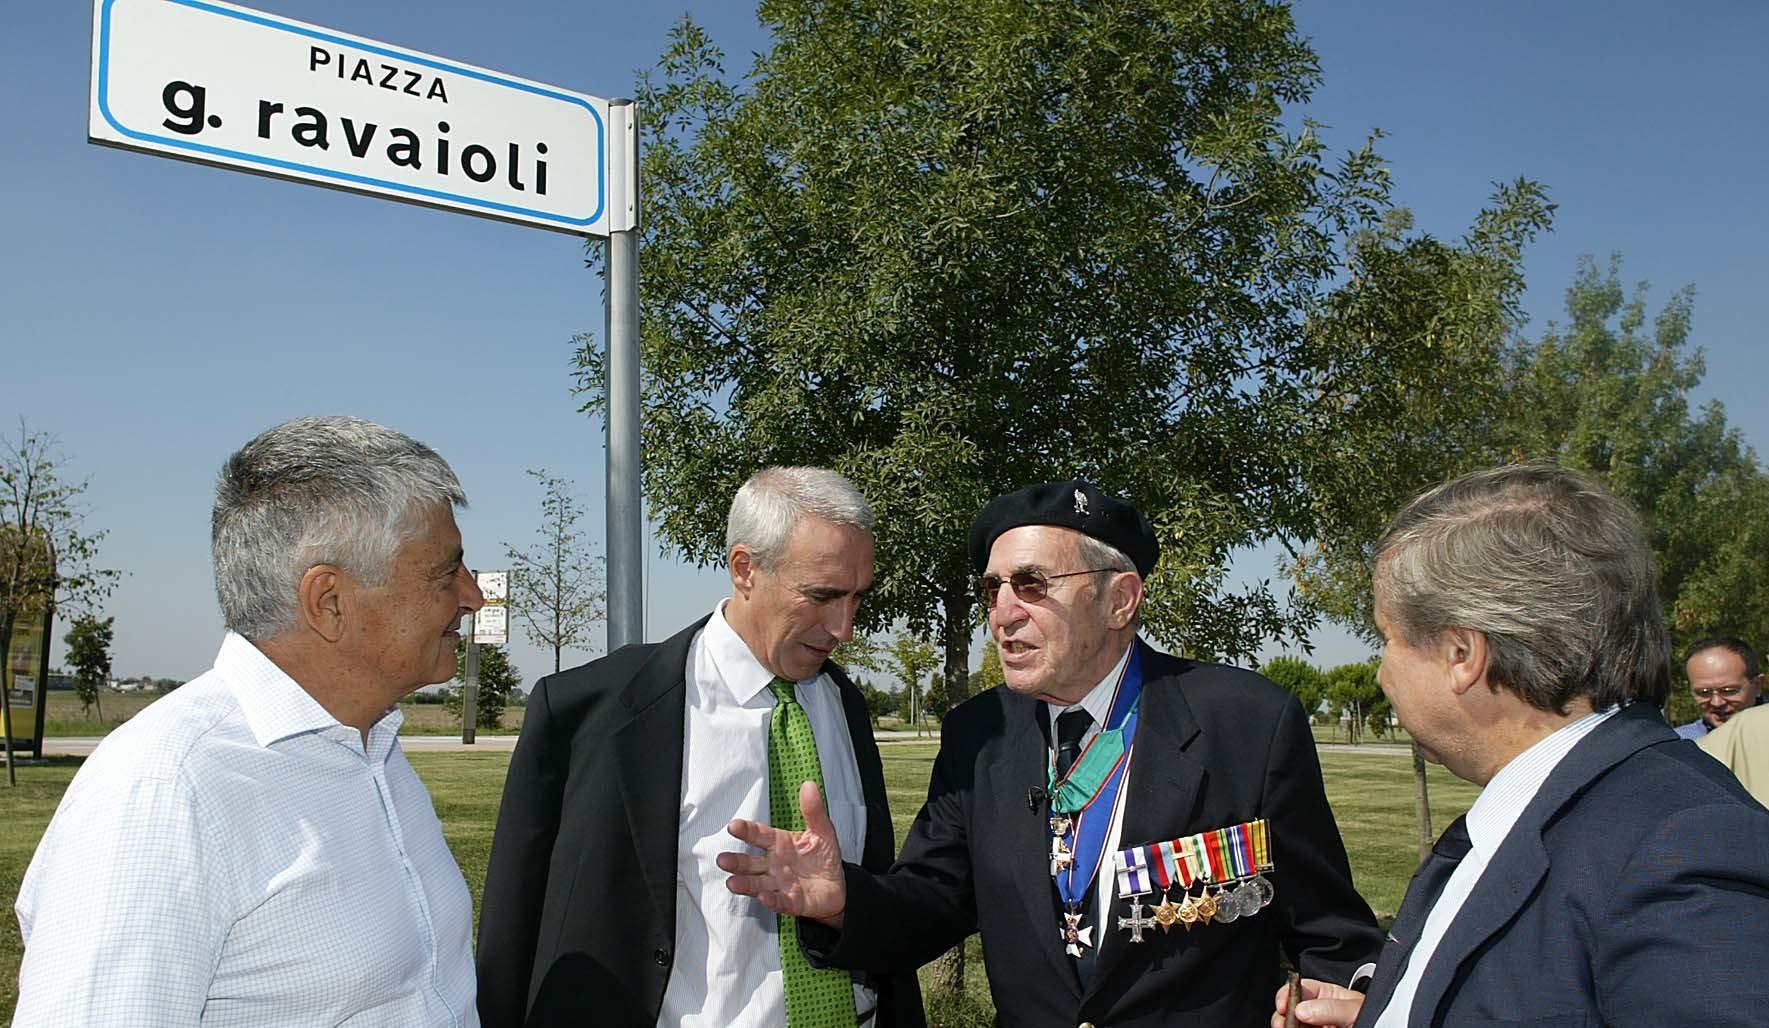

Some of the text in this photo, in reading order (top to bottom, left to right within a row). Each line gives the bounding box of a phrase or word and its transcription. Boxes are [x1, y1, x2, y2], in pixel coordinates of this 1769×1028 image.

[310, 45, 448, 104] PIAZZA
[162, 80, 548, 196] g. ravaioli
